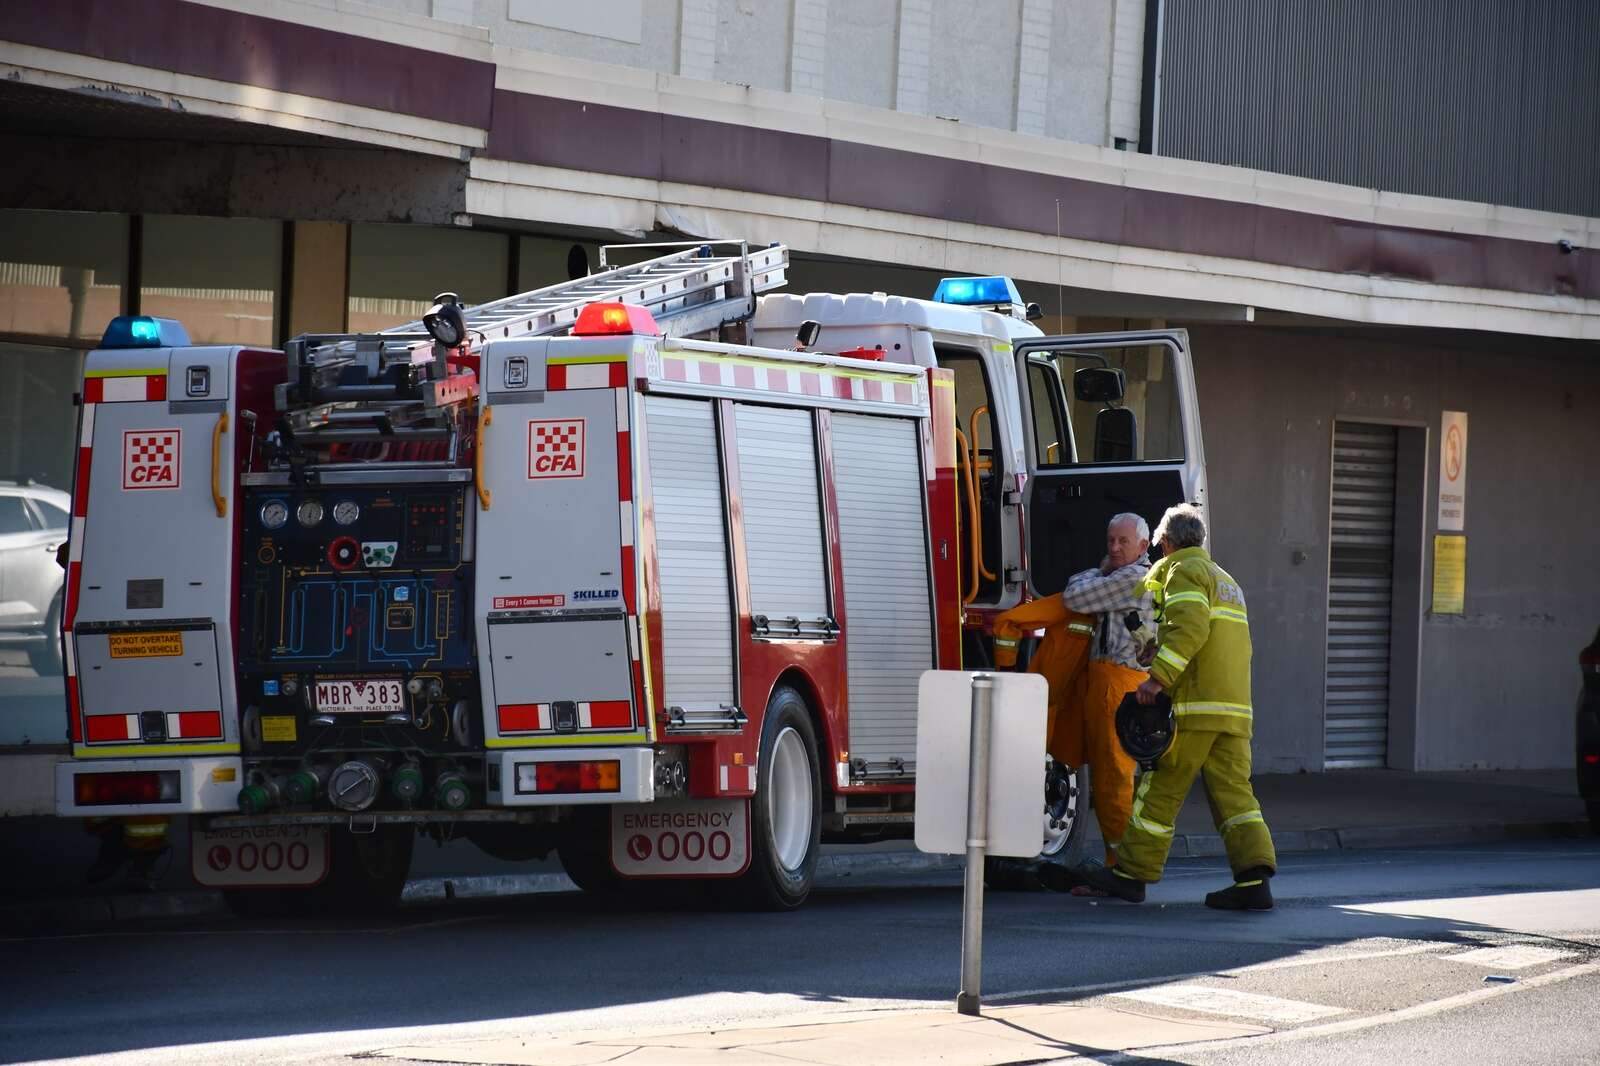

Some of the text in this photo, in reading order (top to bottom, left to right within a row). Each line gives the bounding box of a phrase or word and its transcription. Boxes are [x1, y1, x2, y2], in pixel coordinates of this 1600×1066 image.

[536, 455, 577, 472] CFA
[131, 465, 172, 482] CFA
[505, 599, 518, 607] Every
[523, 598, 539, 606] Comes
[539, 597, 553, 605] Home
[573, 589, 619, 599] SKILLED
[140, 635, 180, 644] OVERTAKE
[113, 645, 180, 655] TURNING VEHICLE
[318, 685, 400, 705] MBR 383
[624, 812, 733, 828] EMERGENCY
[658, 830, 731, 861] 000
[238, 841, 309, 872] 000
